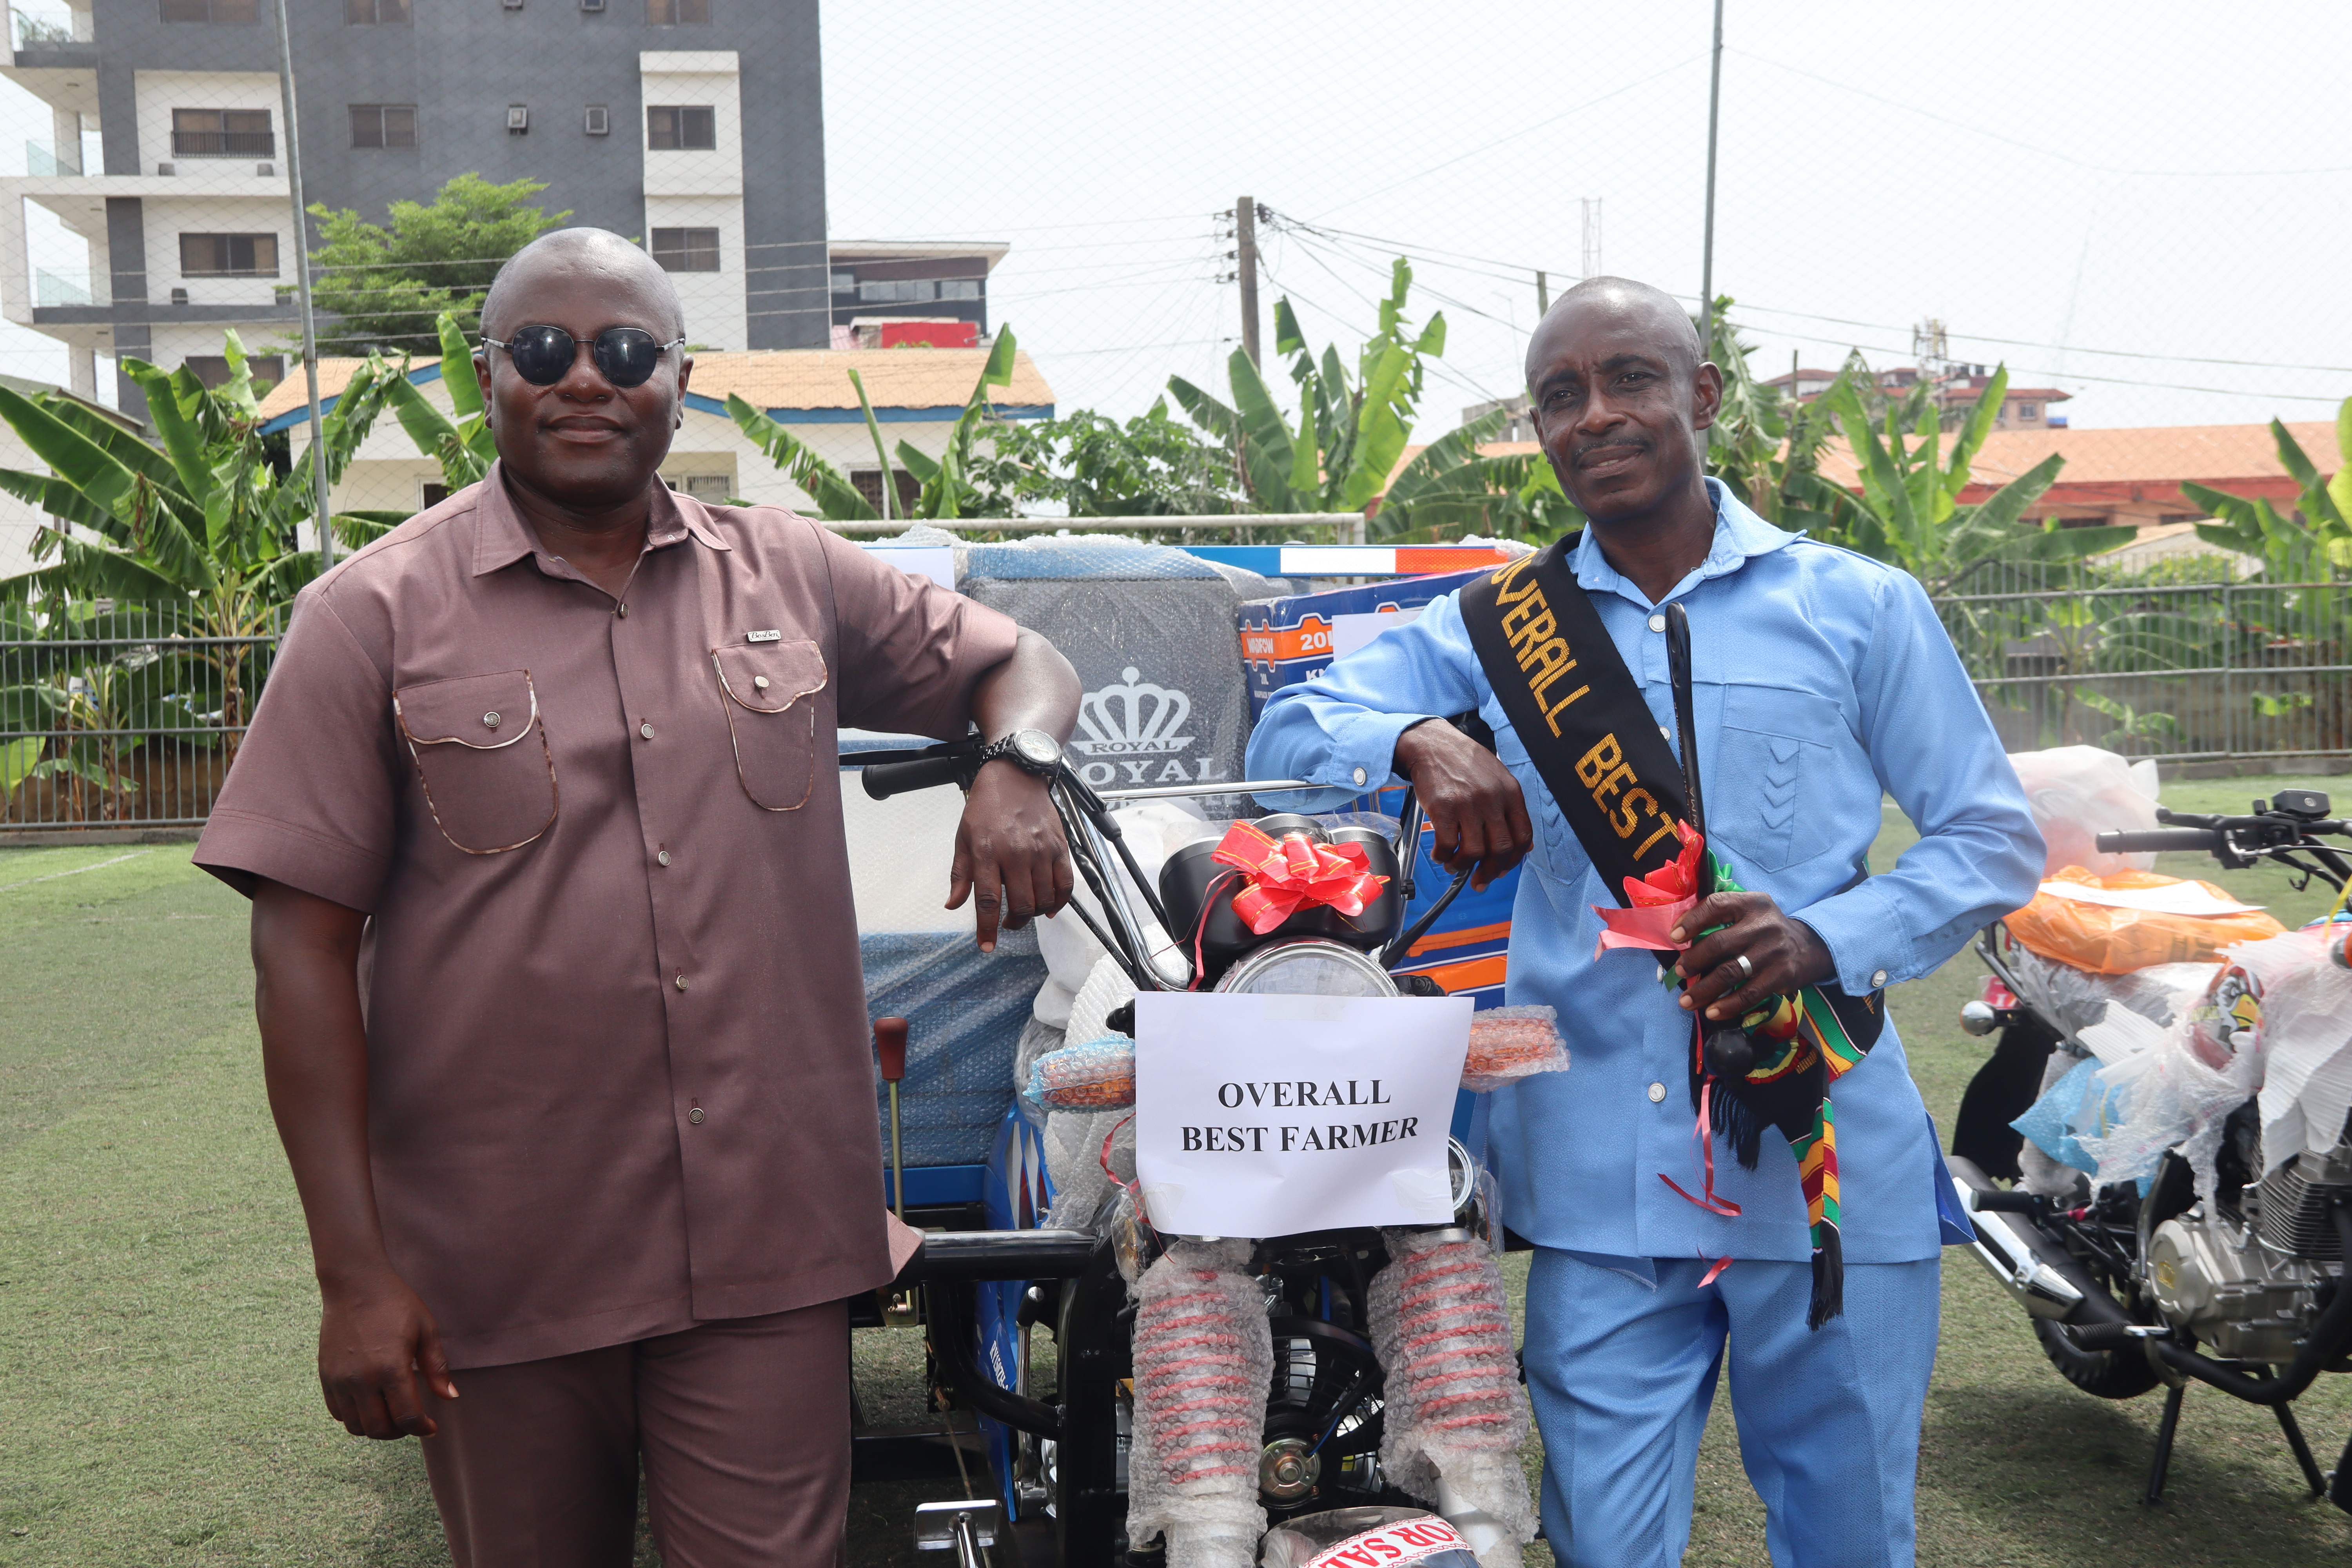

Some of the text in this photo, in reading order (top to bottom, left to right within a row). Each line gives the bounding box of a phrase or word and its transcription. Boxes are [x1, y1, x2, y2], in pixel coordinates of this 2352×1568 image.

[1247, 638, 1274, 653] WADFOW
[1260, 673, 1269, 685] 20L
[1491, 551, 1681, 861] OVERALL BEST
[1091, 740, 1178, 753] ROYAL
[1080, 757, 1228, 784] OYAL
[1074, 904, 1085, 919] ROYAL
[1092, 926, 1105, 942] ROYAL
[1112, 950, 1124, 967] ROYAL
[1218, 1080, 1391, 1108] OVERALL
[1181, 1117, 1419, 1152] BEST FARMER
[1387, 1522, 1468, 1546] FOR
